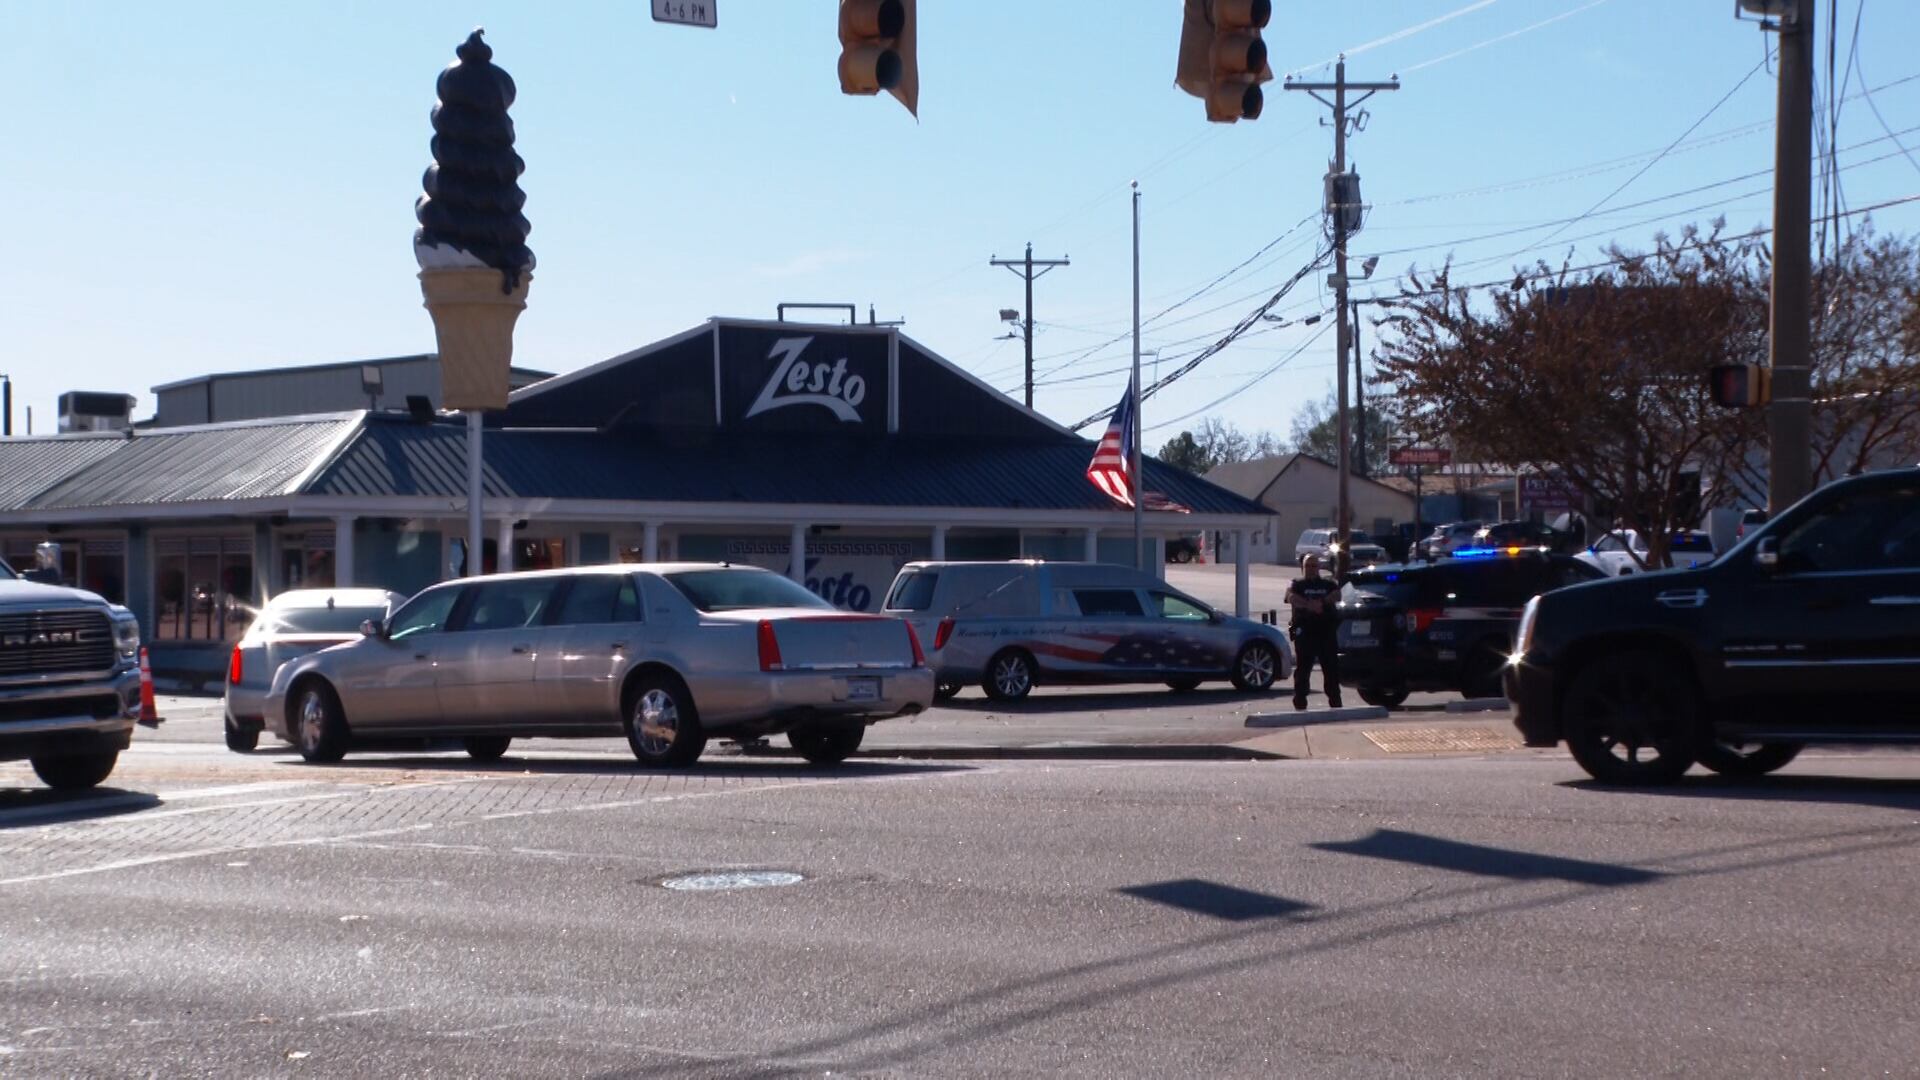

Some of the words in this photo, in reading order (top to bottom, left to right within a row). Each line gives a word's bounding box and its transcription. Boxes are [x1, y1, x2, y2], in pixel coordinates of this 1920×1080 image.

[663, 1, 686, 18] 4-6
[691, 3, 706, 21] PM
[745, 335, 866, 422] Zesto
[4, 632, 73, 645] RAM
